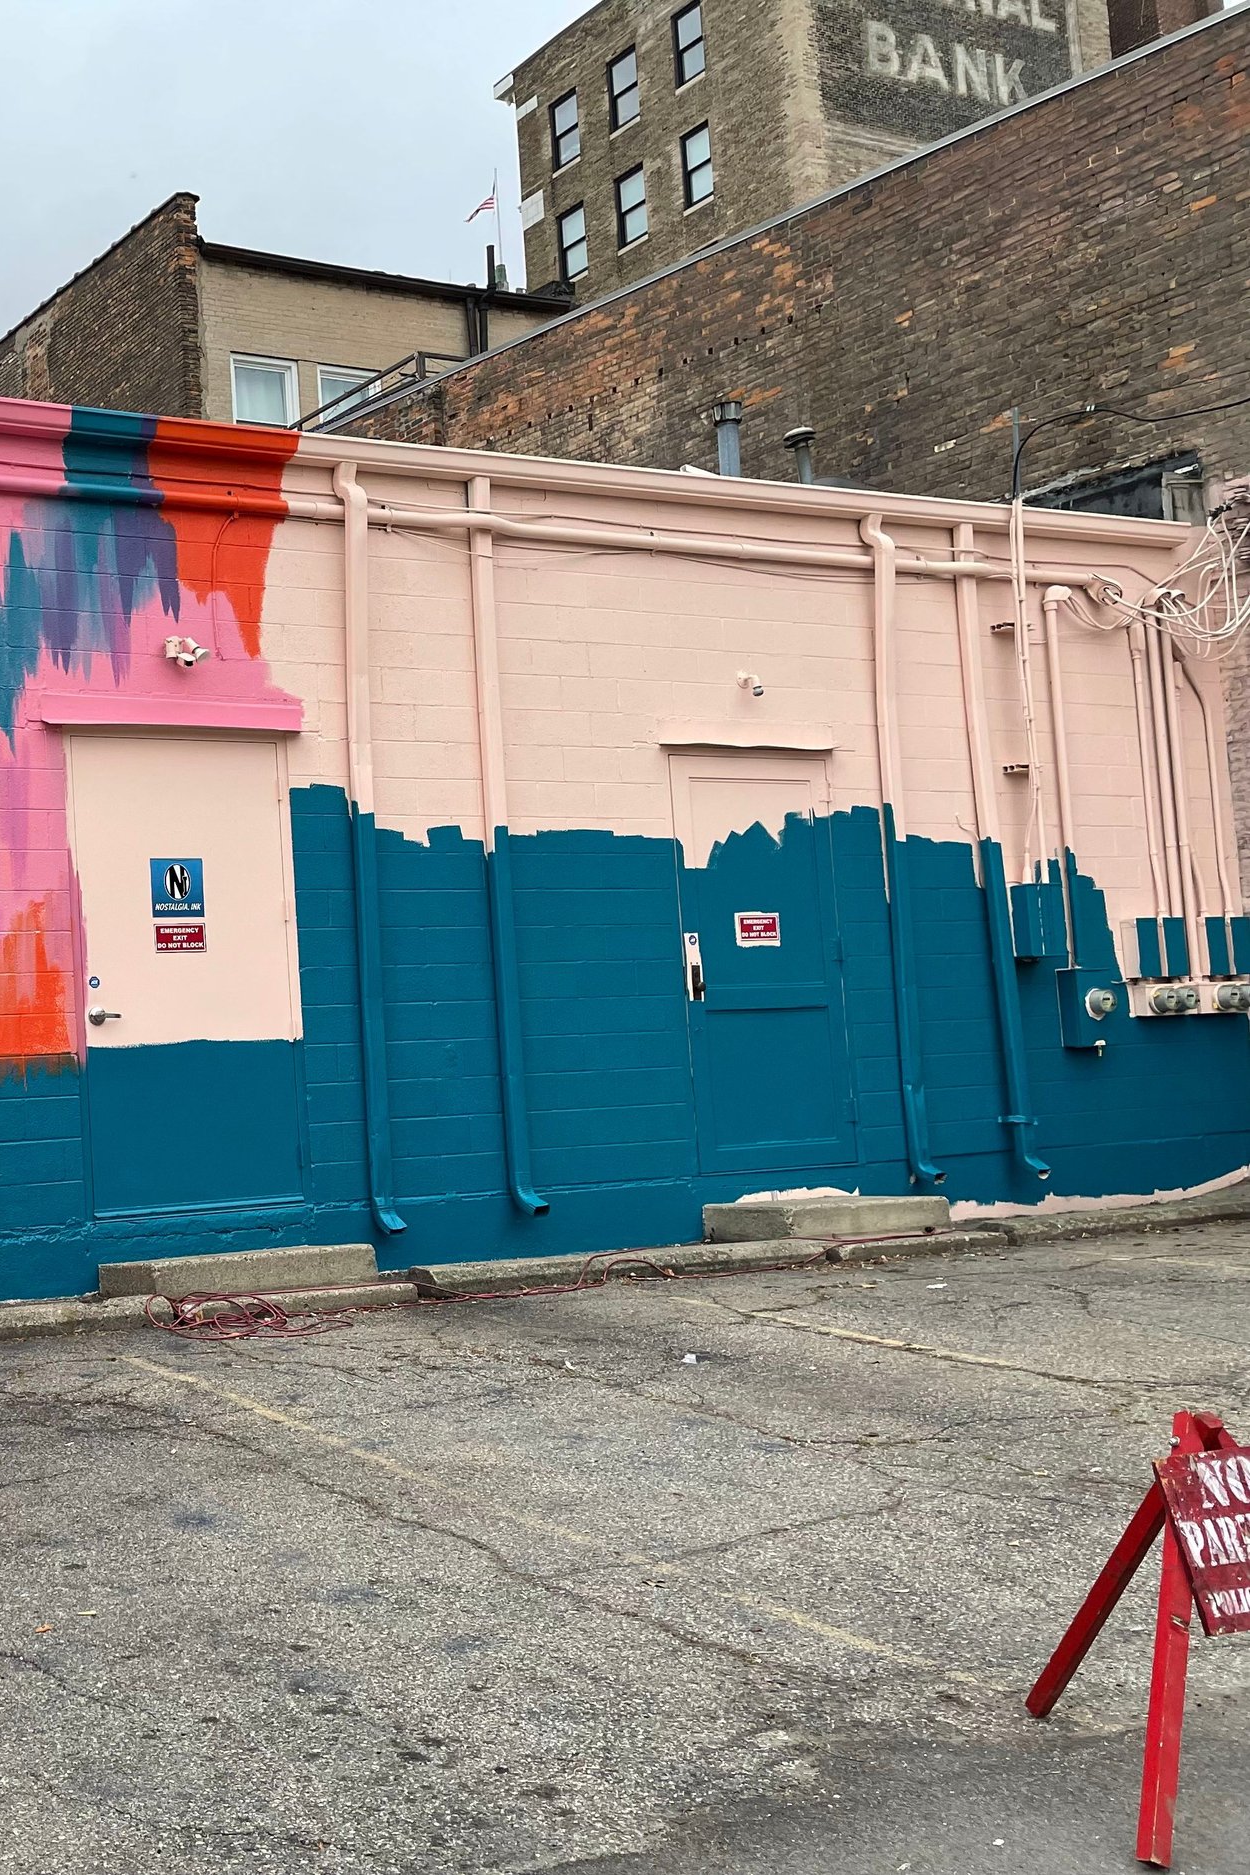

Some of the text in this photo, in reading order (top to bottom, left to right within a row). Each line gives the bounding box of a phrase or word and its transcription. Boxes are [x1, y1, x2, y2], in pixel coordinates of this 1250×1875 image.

[862, 20, 1028, 106] BANK
[191, 903, 201, 911] INK
[1197, 1456, 1250, 1509] NO
